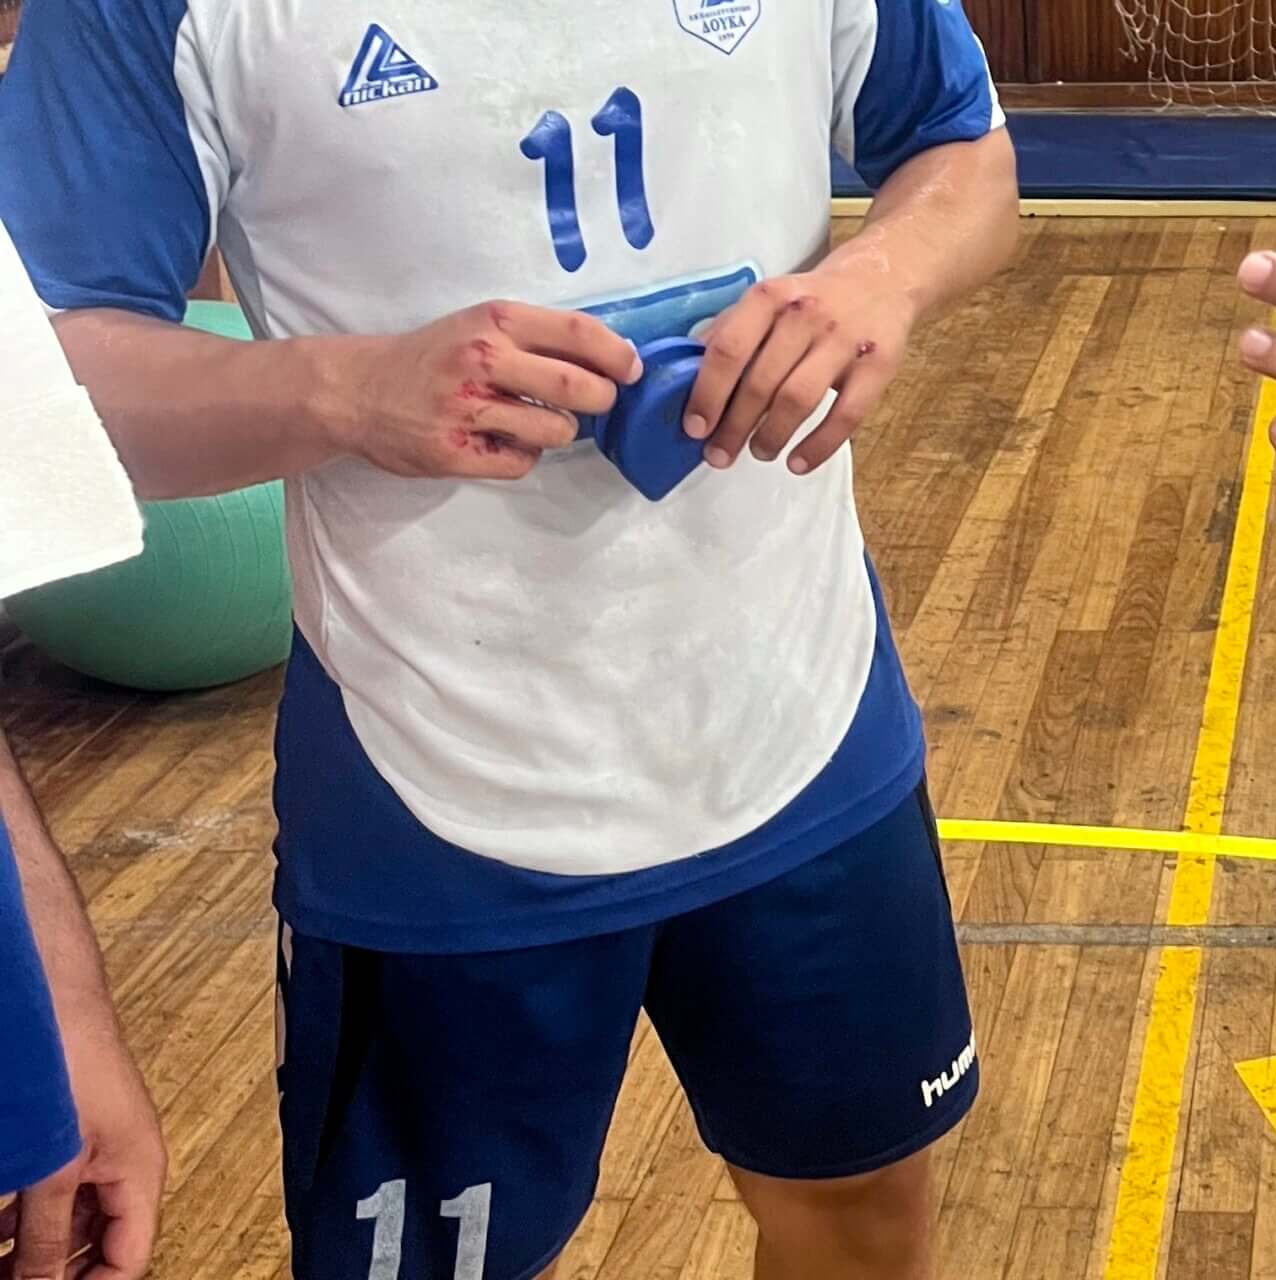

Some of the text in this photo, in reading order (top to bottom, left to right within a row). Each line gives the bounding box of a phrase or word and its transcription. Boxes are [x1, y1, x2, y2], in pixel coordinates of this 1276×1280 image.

[702, 15, 747, 34] ΔΟΥΚΑ
[343, 77, 431, 105] nickan
[519, 86, 655, 273] 11
[921, 1030, 976, 1108] hum
[356, 1179, 492, 1280] 11
